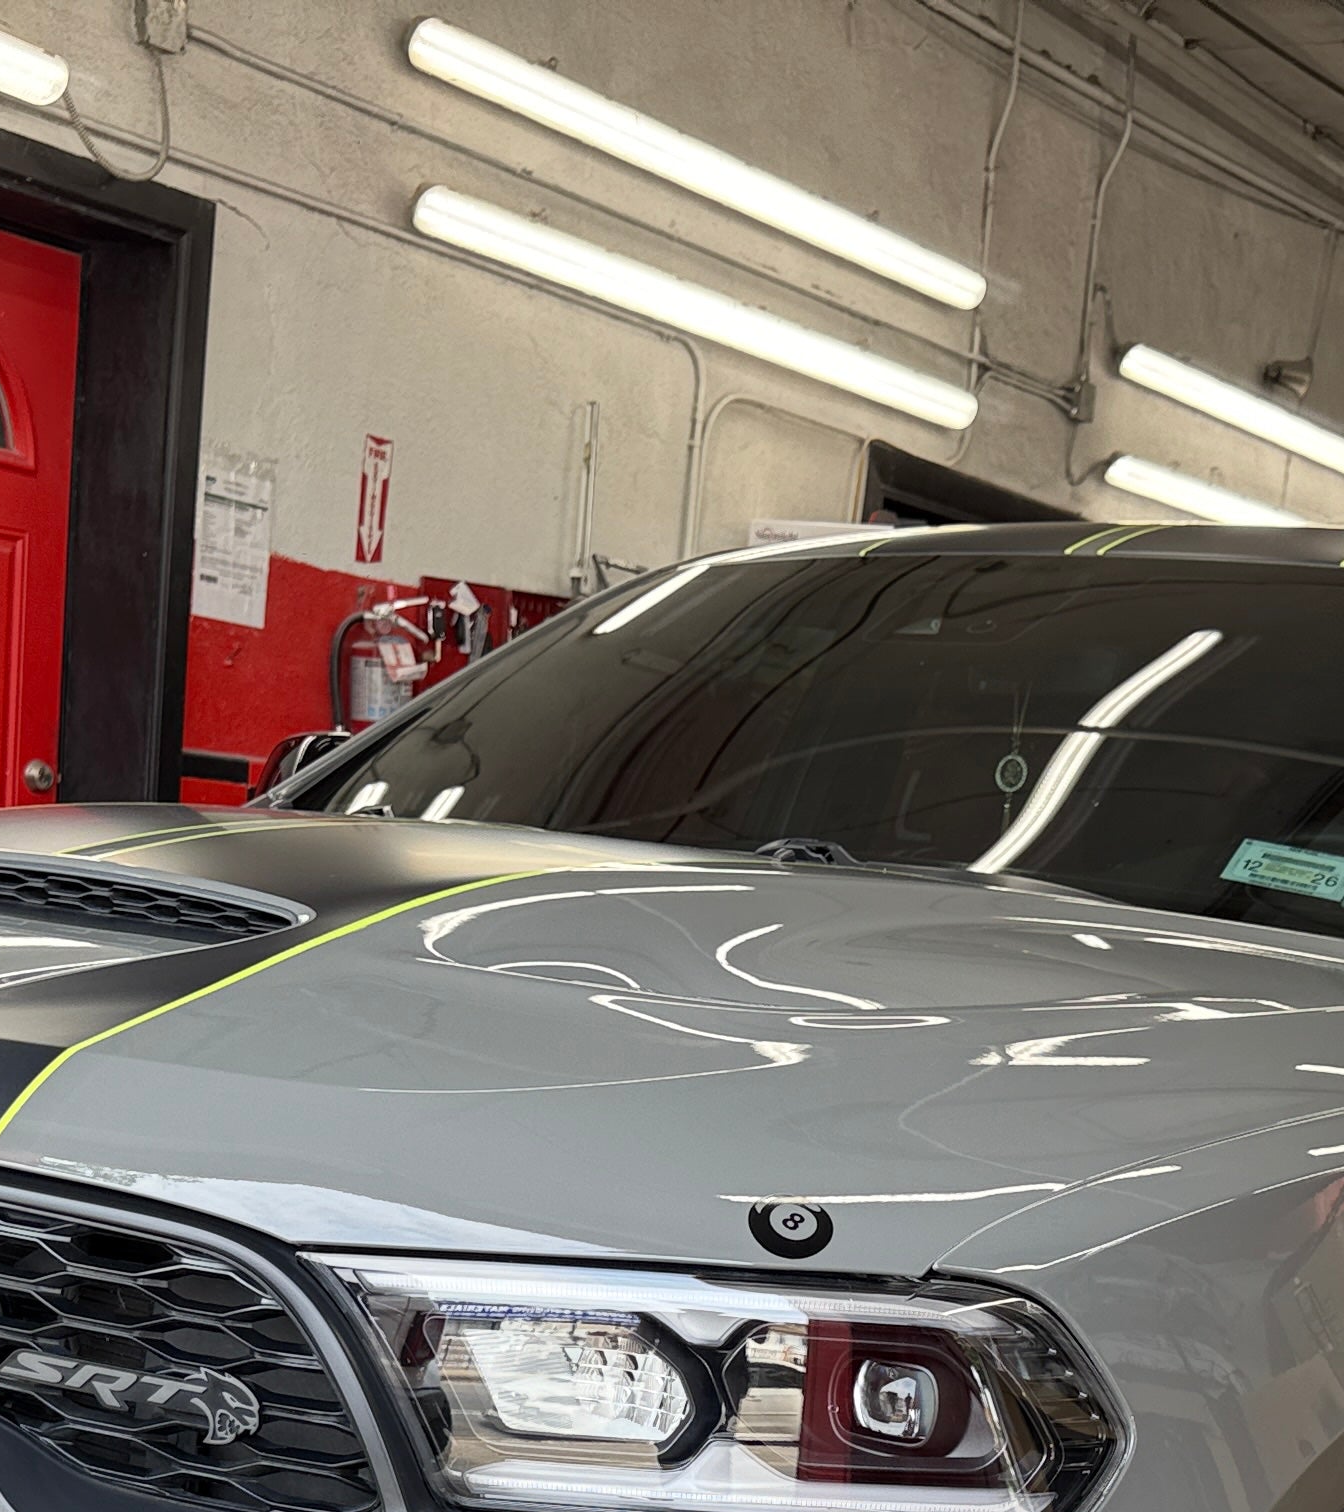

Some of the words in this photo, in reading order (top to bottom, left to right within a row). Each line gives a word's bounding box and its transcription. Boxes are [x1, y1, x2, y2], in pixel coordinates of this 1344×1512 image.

[1243, 858, 1263, 873] 12
[1310, 872, 1339, 888] 26
[782, 1213, 805, 1230] 8
[1, 1351, 206, 1409] SRT
